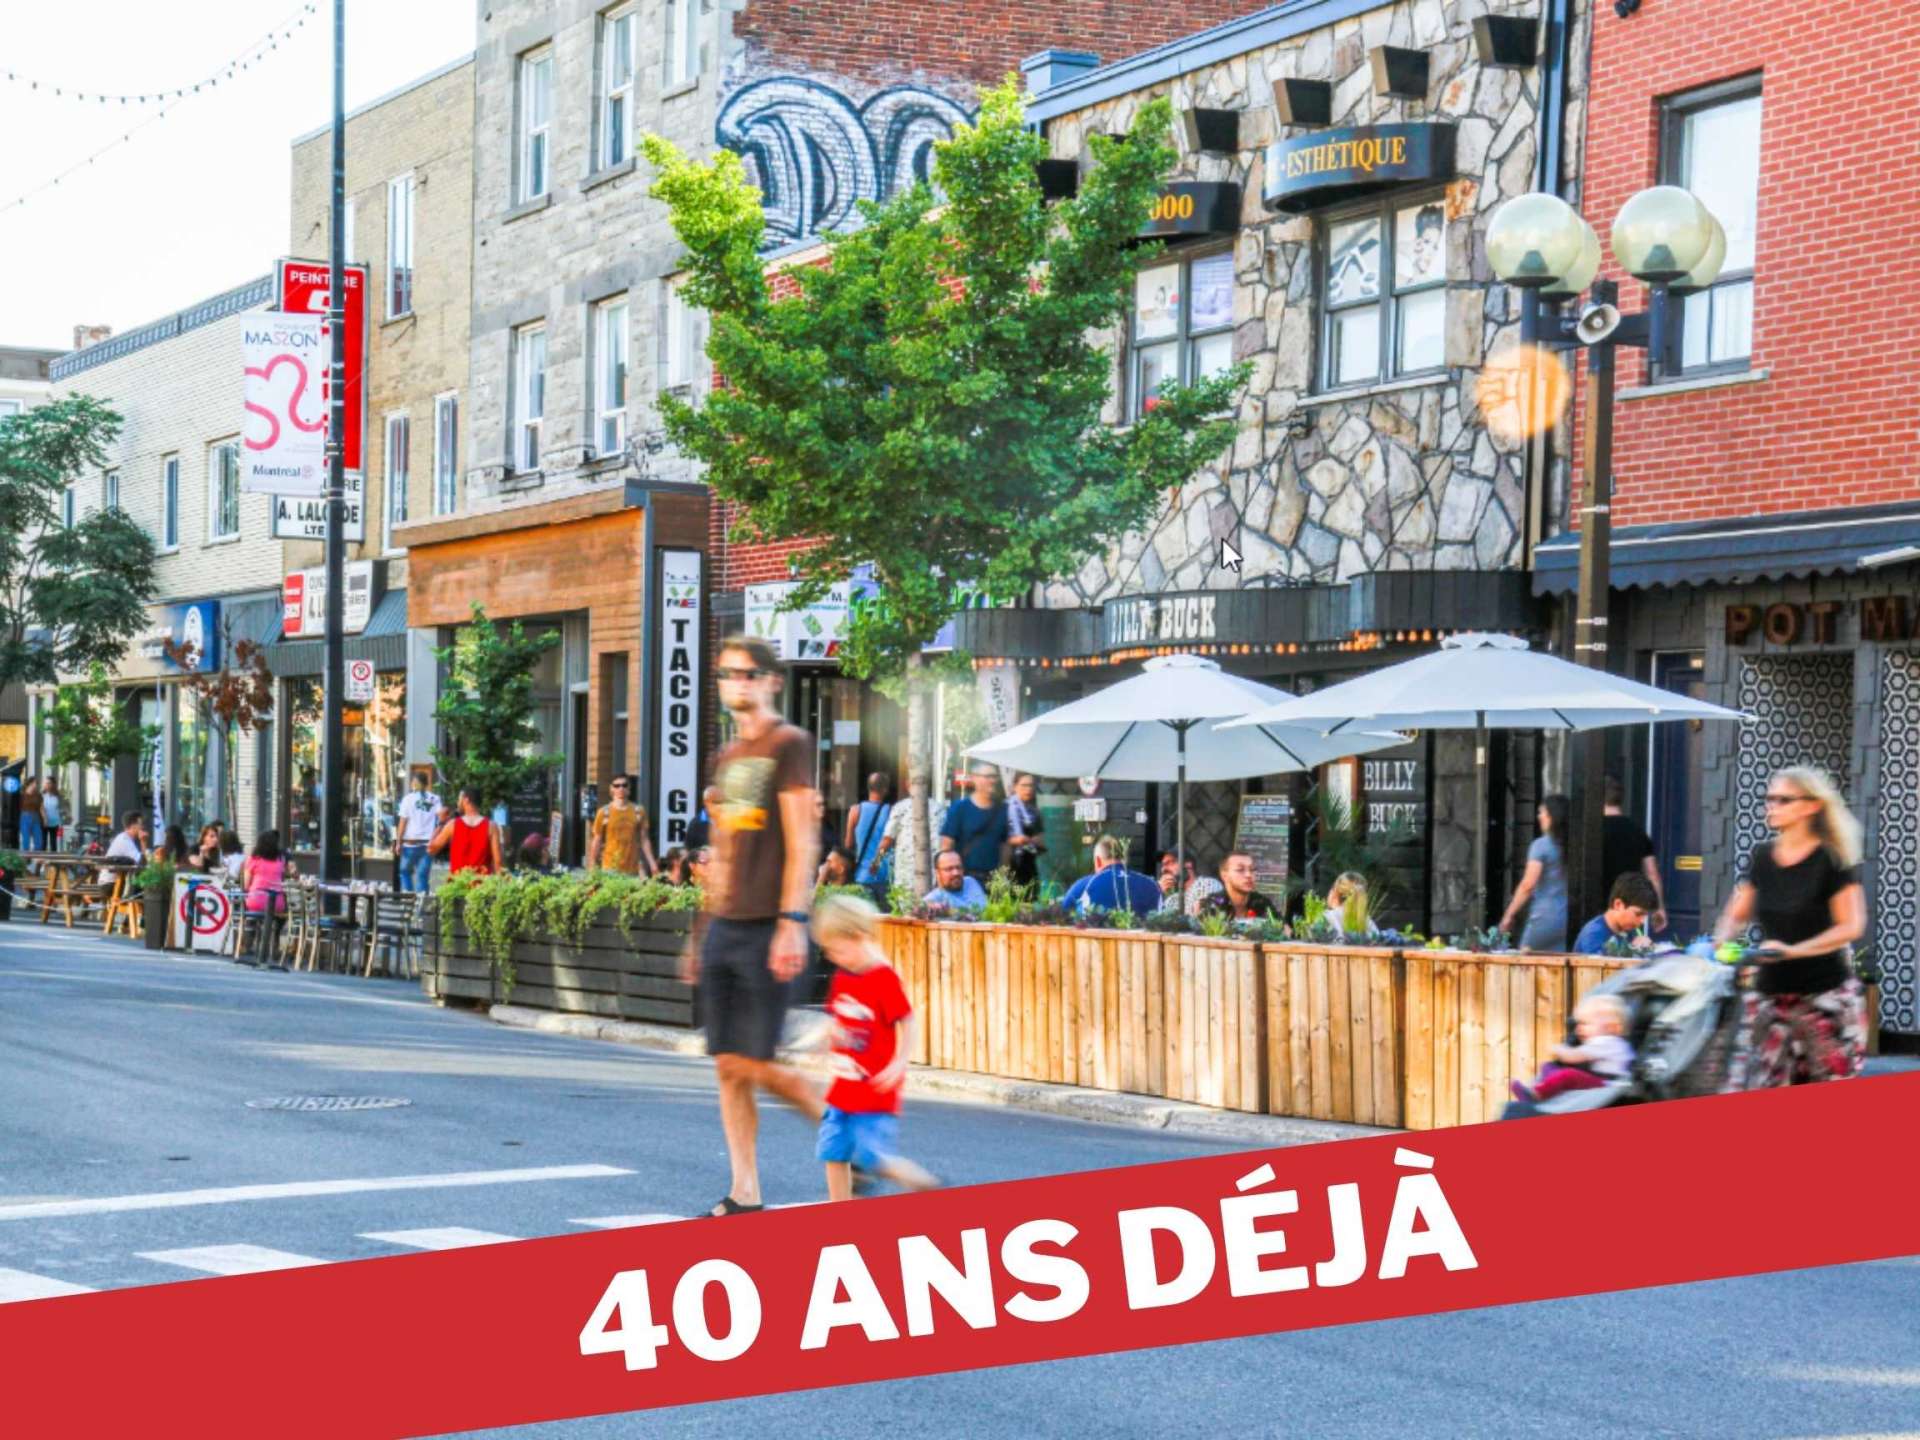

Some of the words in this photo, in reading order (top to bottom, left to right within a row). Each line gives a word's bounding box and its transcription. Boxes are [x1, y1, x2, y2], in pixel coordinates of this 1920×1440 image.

[1286, 136, 1406, 178] ESTHÉTIQUE
[289, 270, 359, 289] PEINTRE
[278, 500, 292, 520] A.
[297, 501, 360, 524] LALDE
[1160, 596, 1215, 639] BUCK
[1725, 602, 1842, 646] POT
[1861, 596, 1920, 641] M
[669, 618, 692, 757] TACOS
[1364, 761, 1417, 791] BILLY
